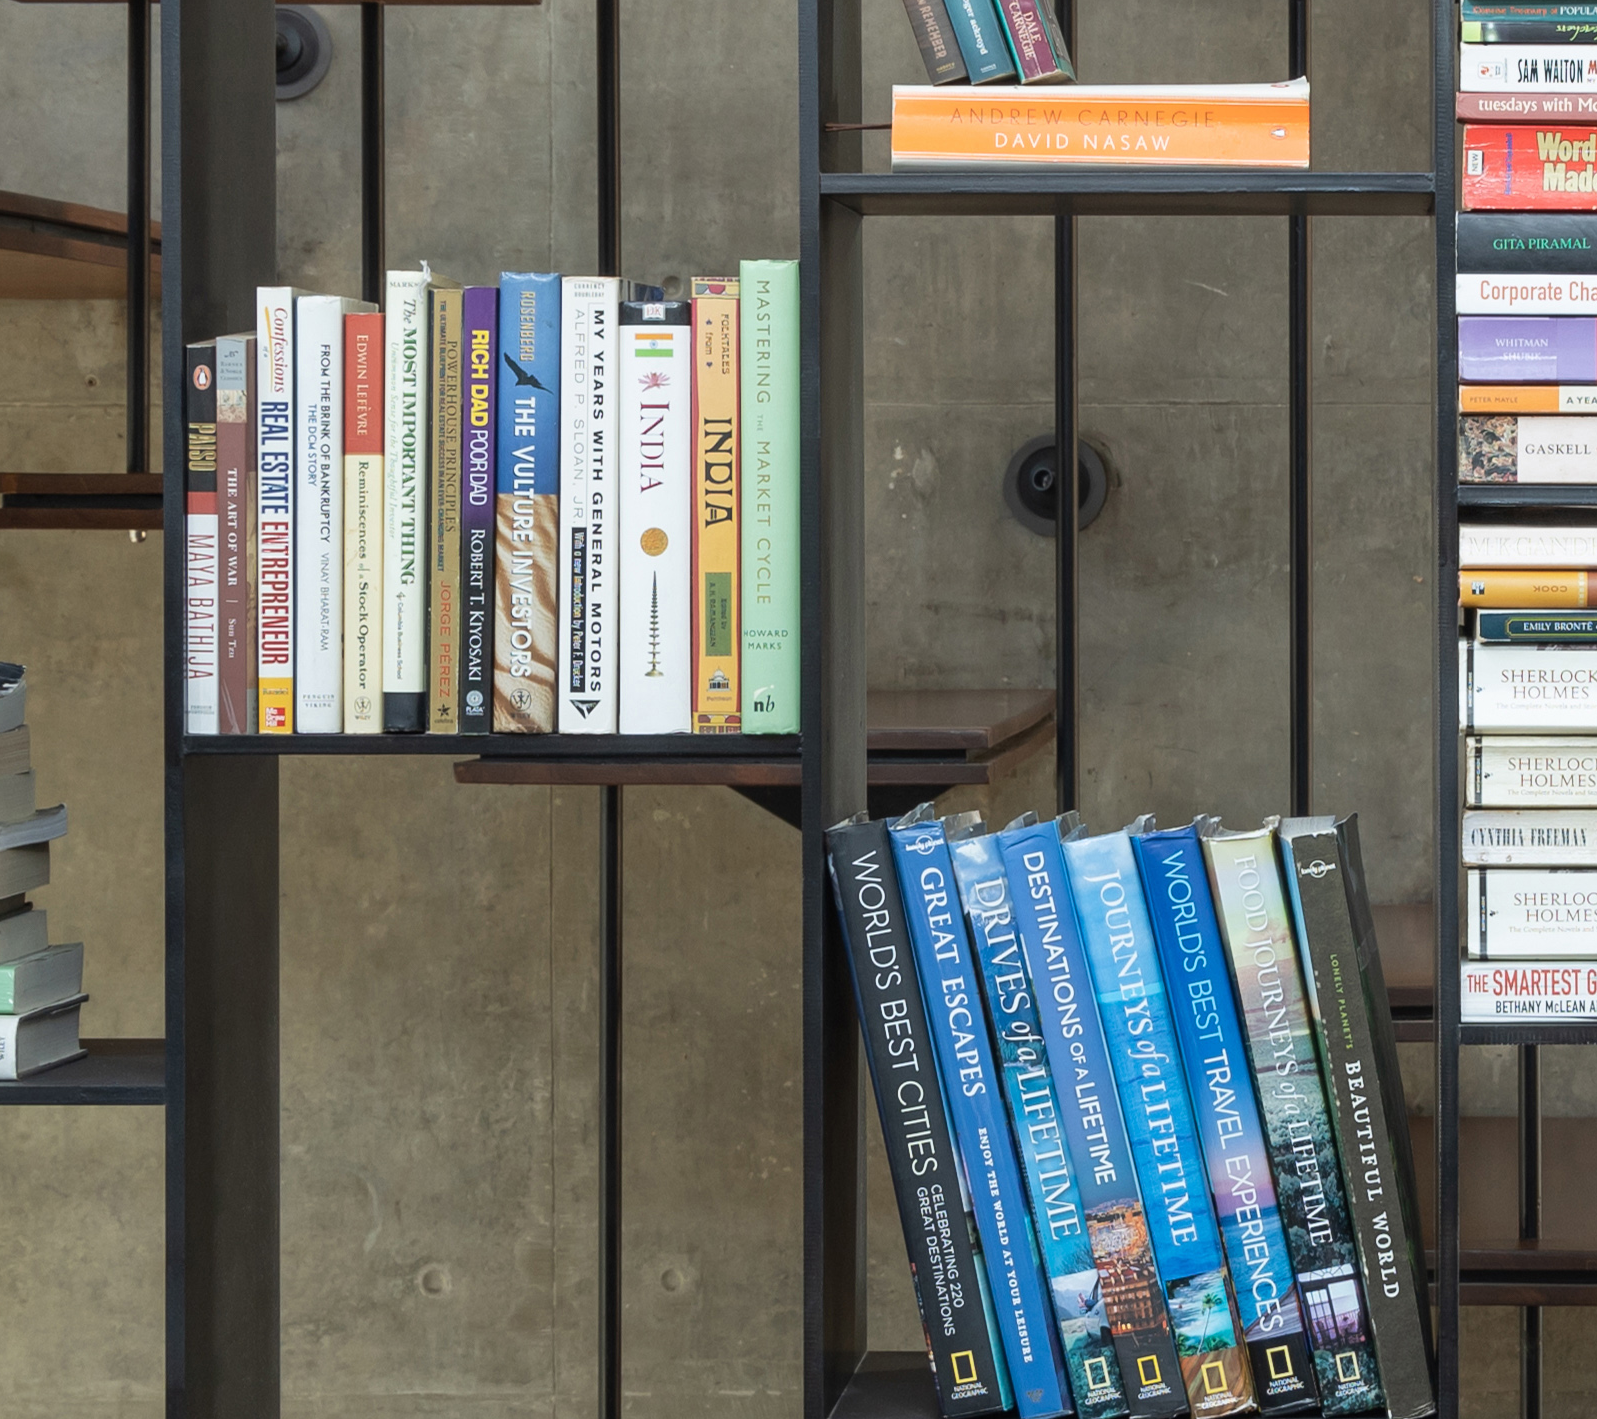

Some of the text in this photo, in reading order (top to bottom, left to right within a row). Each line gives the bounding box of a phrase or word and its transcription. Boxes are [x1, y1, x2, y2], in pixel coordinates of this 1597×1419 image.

[1008, 2, 1035, 60] CARNEGIE
[1022, 10, 1041, 43] DALE
[951, 108, 1214, 128] ANDREW CARNEGIE
[995, 132, 1171, 151] DAVID NASAW
[1537, 132, 1596, 162] Word
[1493, 237, 1590, 250] GITA PIRAMAL
[1480, 280, 1563, 305] Corporate
[356, 334, 370, 379] EDWIN
[639, 401, 670, 494] INDIA
[704, 417, 733, 528] INDIA
[260, 401, 289, 666] REAL ESTATE ENTREPRENEUR
[511, 397, 536, 679] THE VULTURE INVESTORS
[743, 629, 788, 638] HOWARD
[748, 642, 782, 650] MARKS
[1513, 685, 1590, 699] HOLMES
[919, 868, 985, 1098] GREAT ESCAPES
[852, 850, 937, 1175] WORLD'S BEST CITIES
[1330, 953, 1344, 994] LONELY
[1345, 1060, 1384, 1204] BEAUTIFUL
[1372, 1212, 1399, 1299] WORLD
